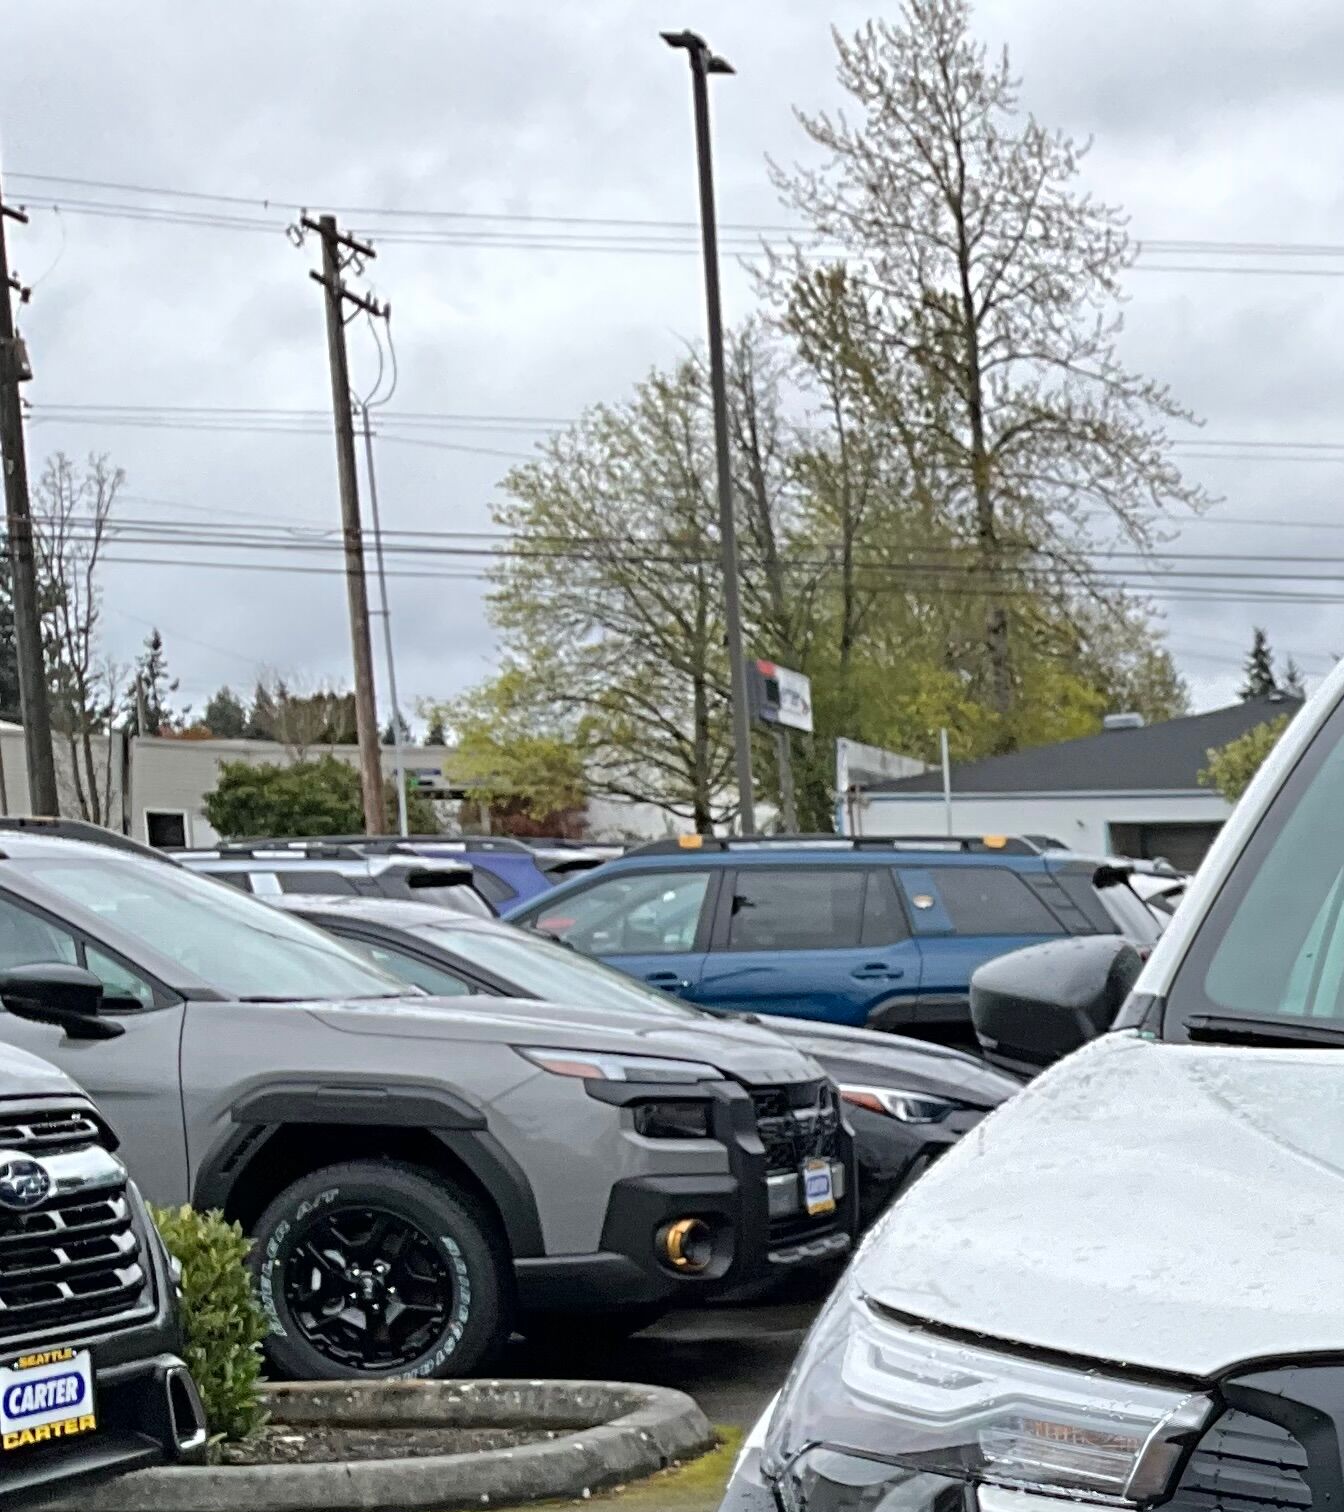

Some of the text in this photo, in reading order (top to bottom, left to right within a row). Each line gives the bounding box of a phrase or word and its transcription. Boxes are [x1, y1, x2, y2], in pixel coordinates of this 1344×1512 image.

[18, 1346, 74, 1370] SEATTLE
[8, 1375, 79, 1416] CARTER
[2, 1414, 97, 1451] CARTER
